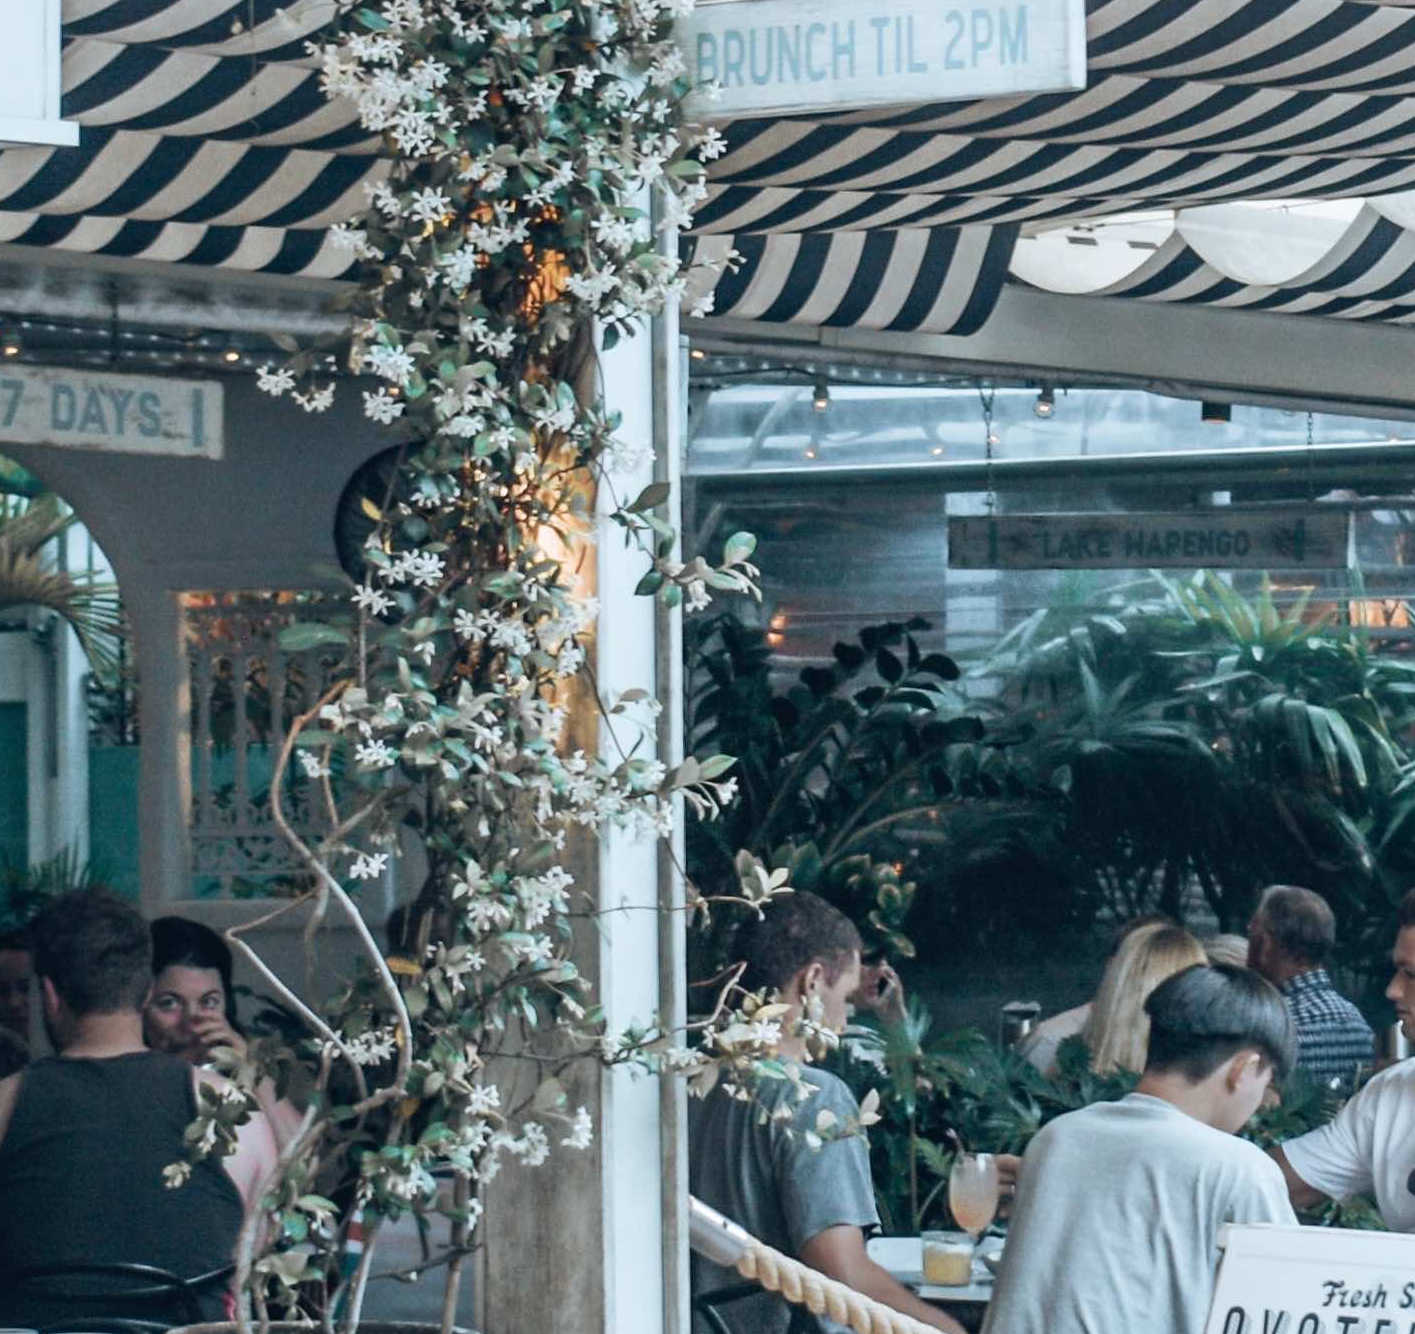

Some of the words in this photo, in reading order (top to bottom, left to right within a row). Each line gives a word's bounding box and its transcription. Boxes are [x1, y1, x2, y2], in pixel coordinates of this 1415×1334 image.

[695, 20, 856, 87] BRUNCH
[870, 14, 928, 76] TIL
[944, 4, 1030, 70] 2PM
[0, 378, 26, 428] 7
[50, 383, 163, 439] DAYS
[1043, 530, 1114, 560] LAKE
[1322, 1279, 1387, 1310] Fresh
